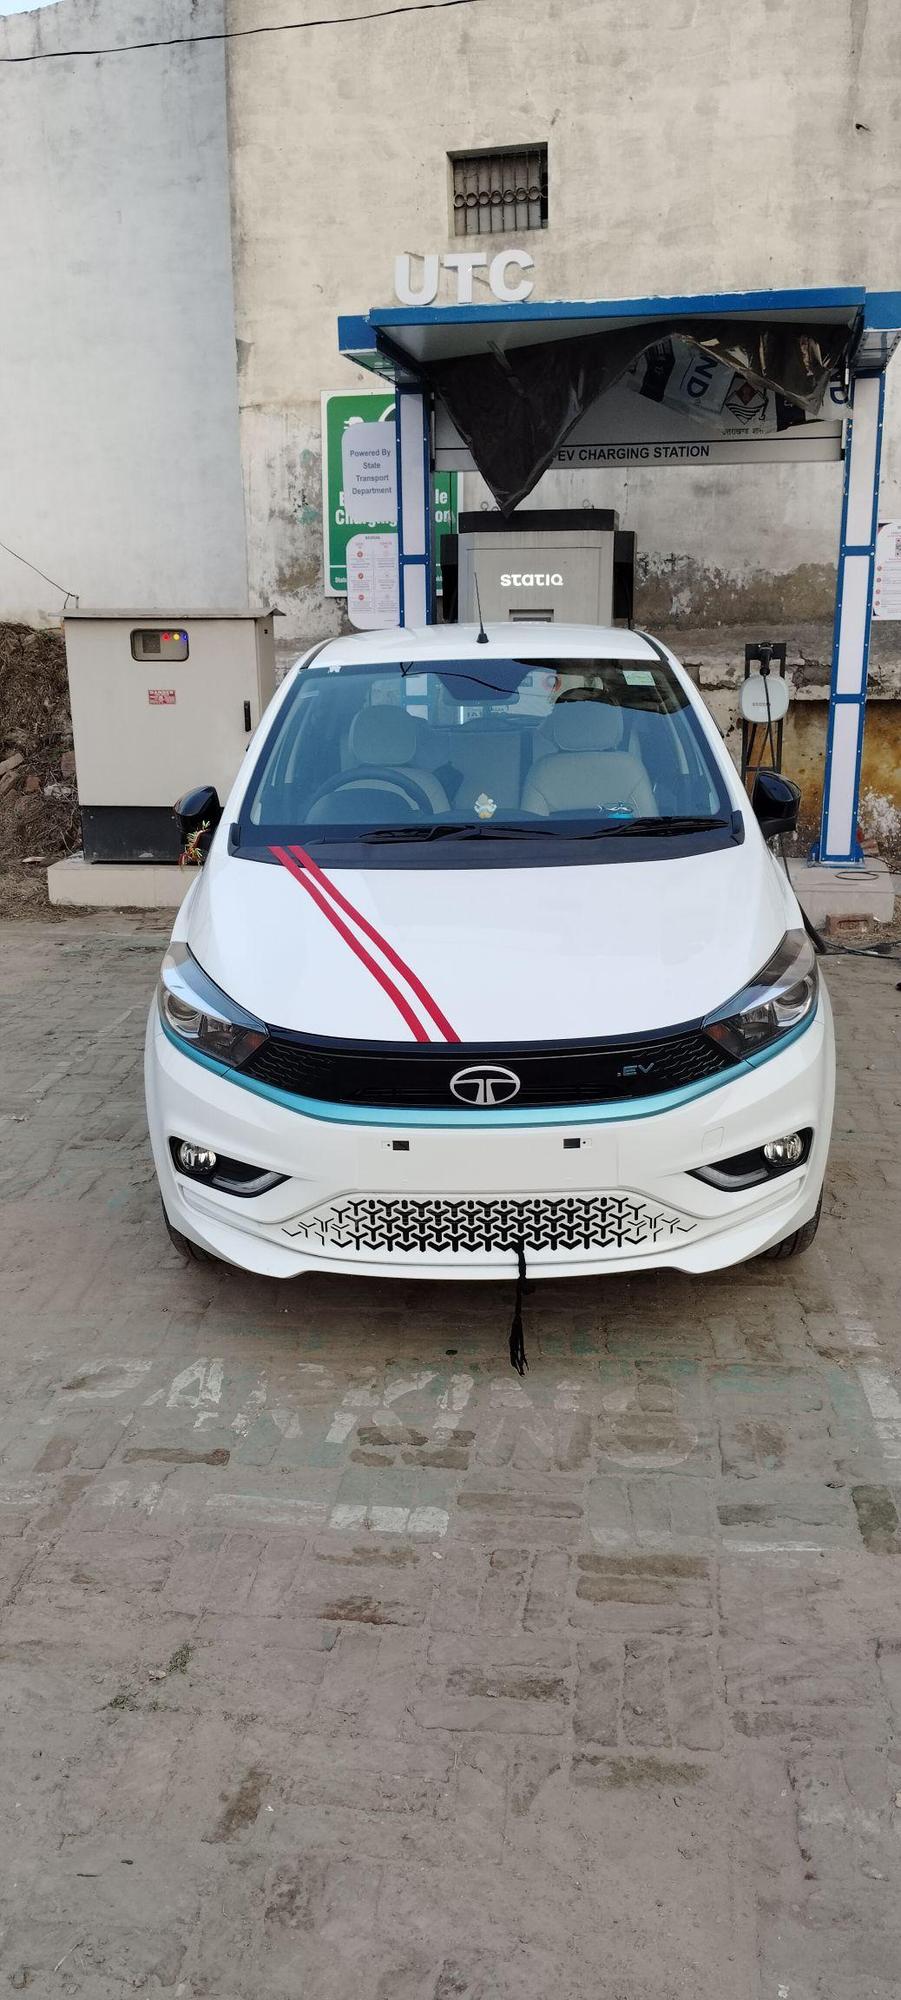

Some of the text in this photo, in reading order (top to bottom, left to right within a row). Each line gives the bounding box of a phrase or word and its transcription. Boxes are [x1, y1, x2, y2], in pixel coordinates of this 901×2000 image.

[395, 249, 535, 306] UTC
[350, 448, 391, 457] Powered By
[579, 447, 649, 461] CHARGING
[653, 445, 710, 459] STATION
[356, 475, 389, 483] Transport
[352, 487, 392, 496] Department
